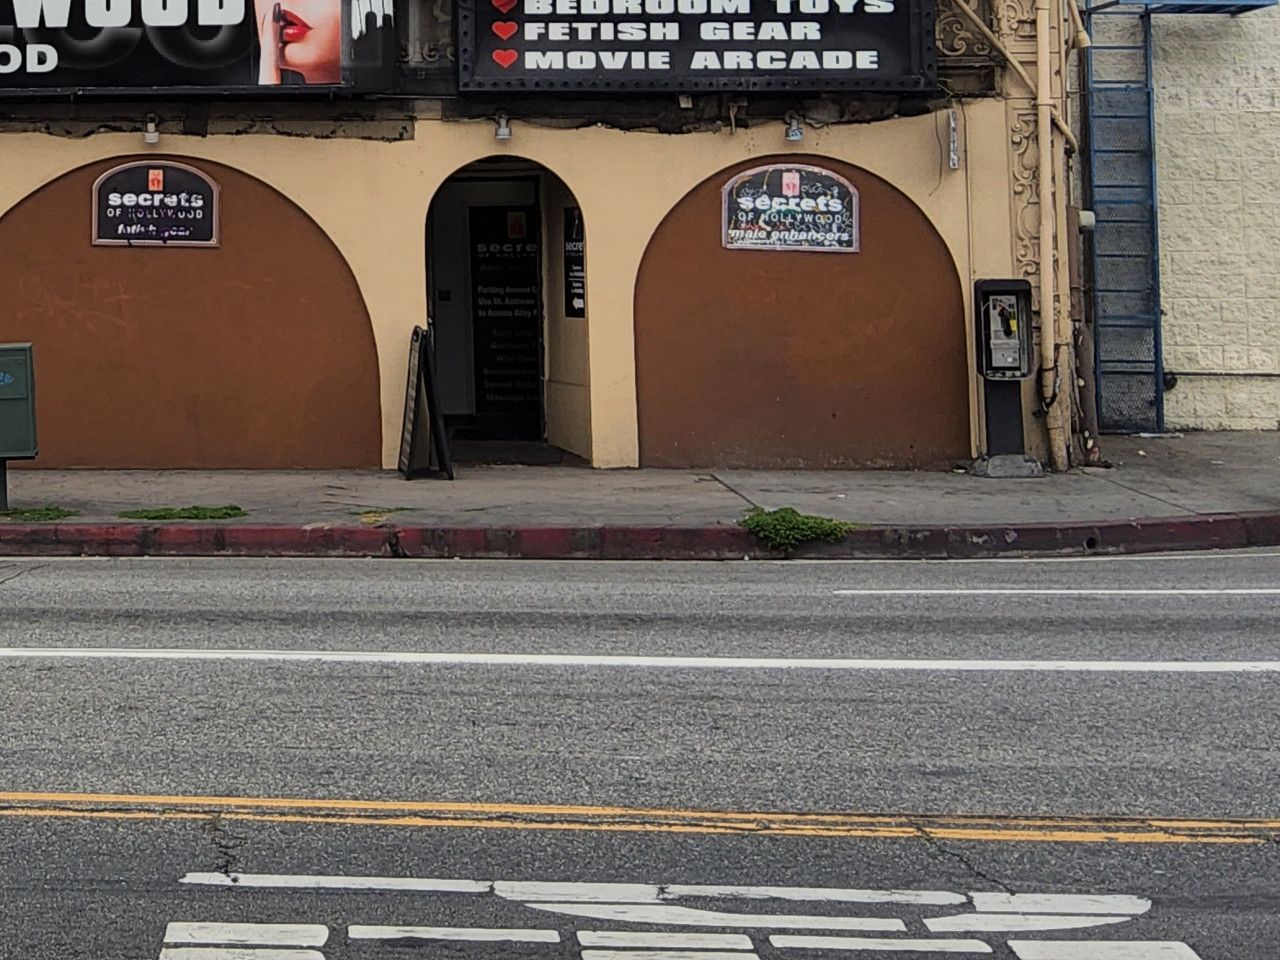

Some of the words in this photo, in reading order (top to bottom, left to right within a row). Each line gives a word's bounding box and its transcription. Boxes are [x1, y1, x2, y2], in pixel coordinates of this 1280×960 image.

[524, 22, 680, 41] FETISH
[700, 21, 822, 40] GEAR
[524, 50, 671, 70] MOVIE
[690, 50, 878, 70] ARCADE
[108, 190, 204, 207] secrets
[737, 194, 843, 211] secrets
[106, 208, 122, 218] OF
[738, 212, 754, 222] OF
[761, 212, 842, 223] HOLLYWOOD
[731, 228, 767, 239] male
[771, 229, 850, 241] enhancers
